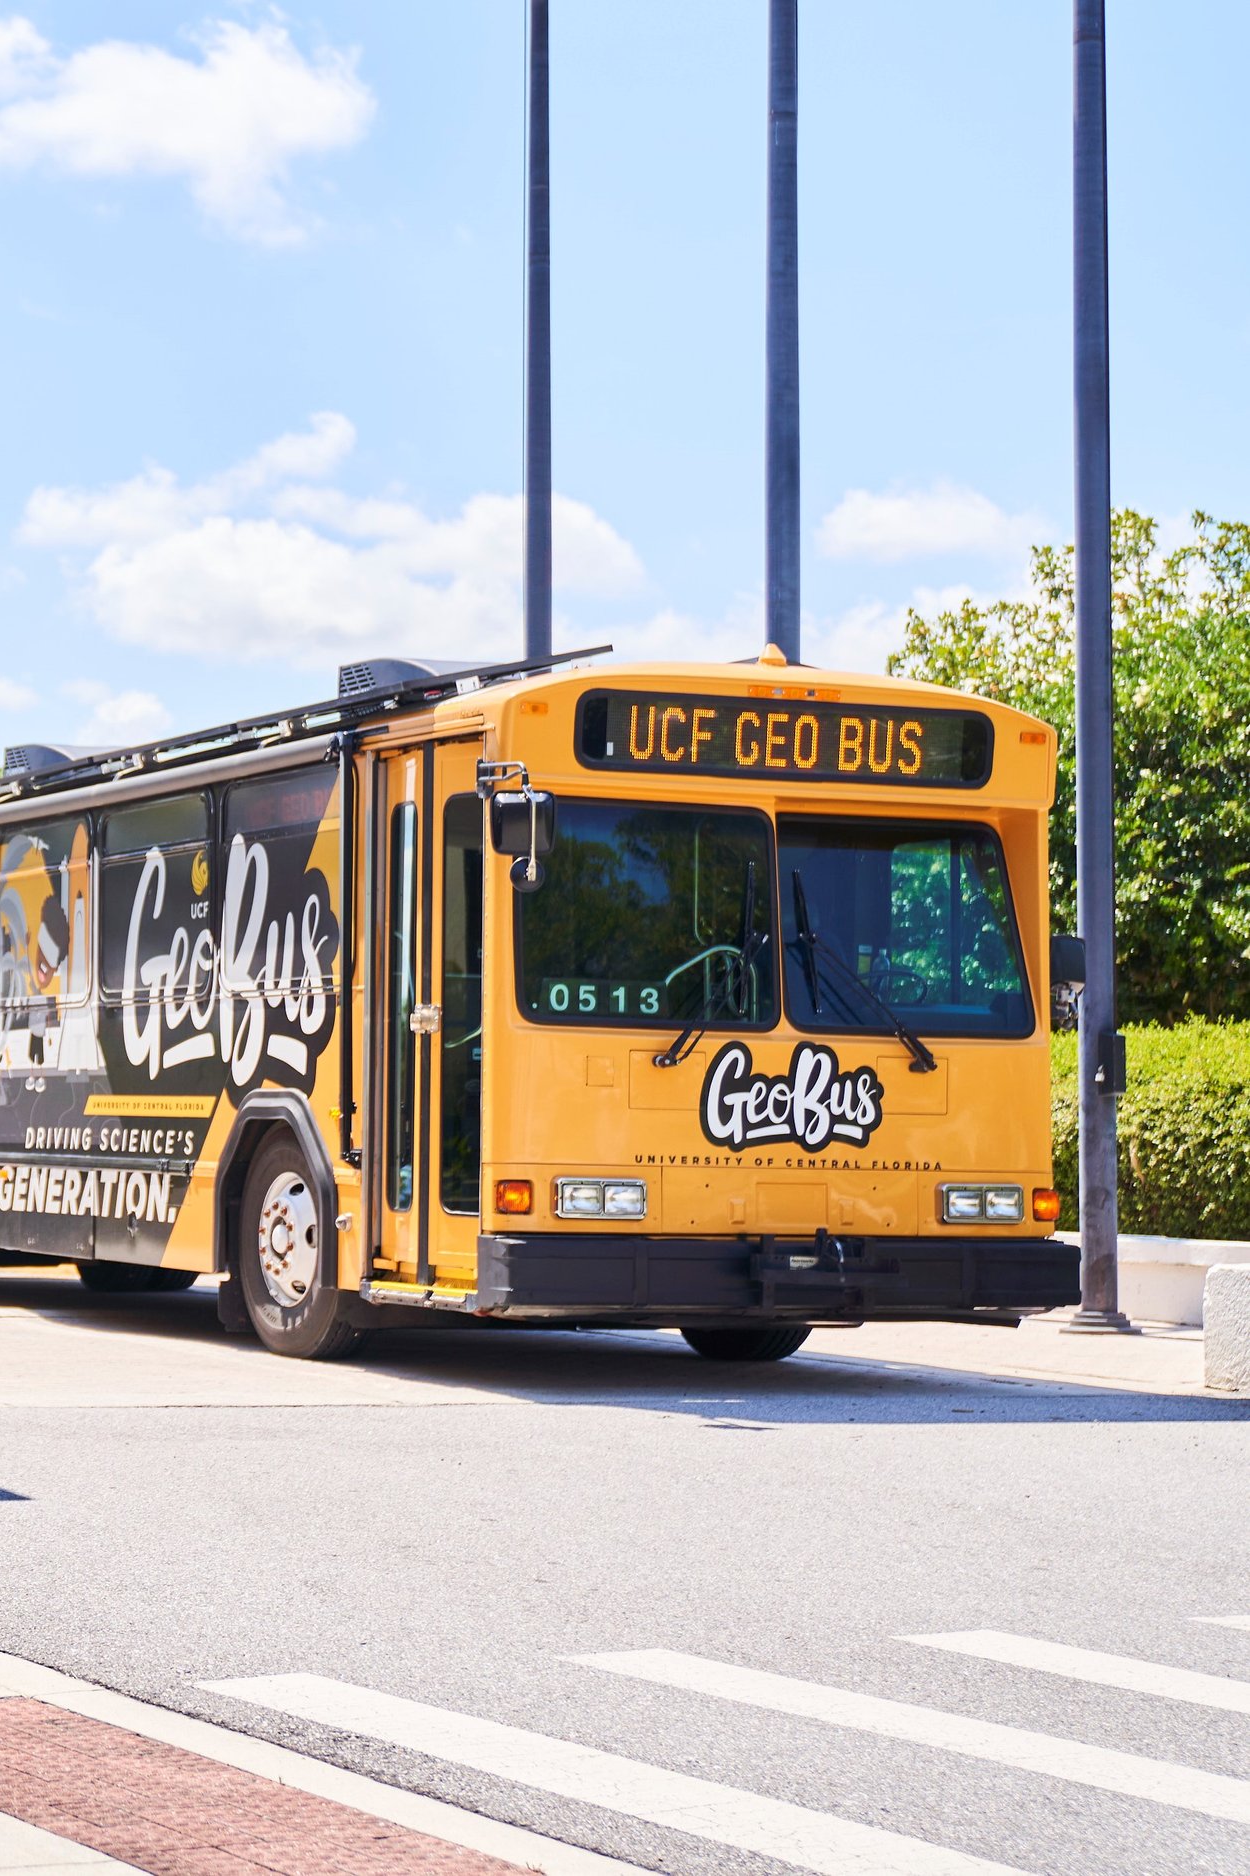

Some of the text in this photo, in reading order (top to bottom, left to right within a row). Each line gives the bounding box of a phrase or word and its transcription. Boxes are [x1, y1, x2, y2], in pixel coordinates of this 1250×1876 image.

[629, 705, 923, 774] UCF GEO BUS
[190, 900, 210, 919] UCF
[121, 833, 329, 1087] GeoBus
[550, 983, 660, 1014] 0513
[92, 1101, 205, 1111] UNIVERSITY OF CENTRAL FLORIDA
[707, 1047, 877, 1145] GeoBus
[24, 1126, 195, 1155] DRIVING SCIENCE'S
[634, 1154, 943, 1171] UNIVERSITY OF CENTRAL FLORIDA
